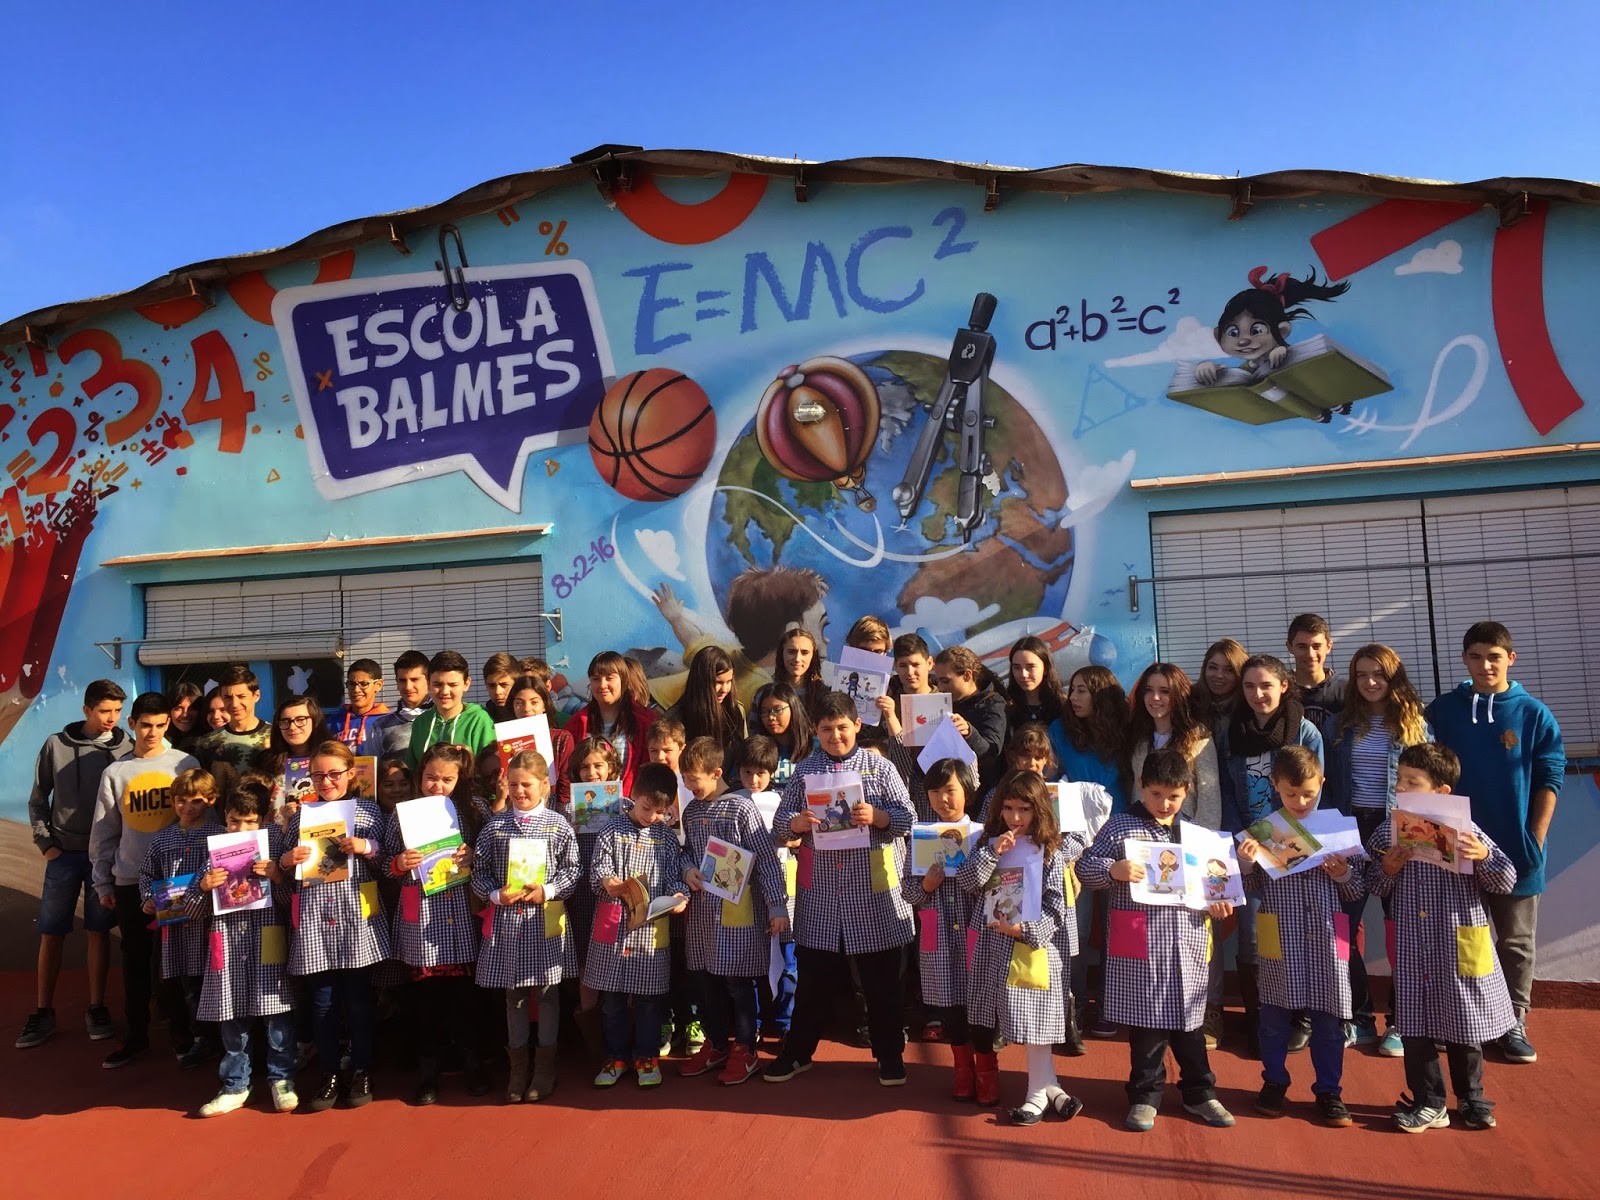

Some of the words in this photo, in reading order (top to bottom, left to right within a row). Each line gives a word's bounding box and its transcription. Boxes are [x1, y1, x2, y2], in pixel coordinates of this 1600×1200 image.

[325, 286, 560, 377] ESCOLA
[181, 329, 256, 454] 4
[337, 339, 581, 450] BALMES
[129, 786, 172, 813] NICE
